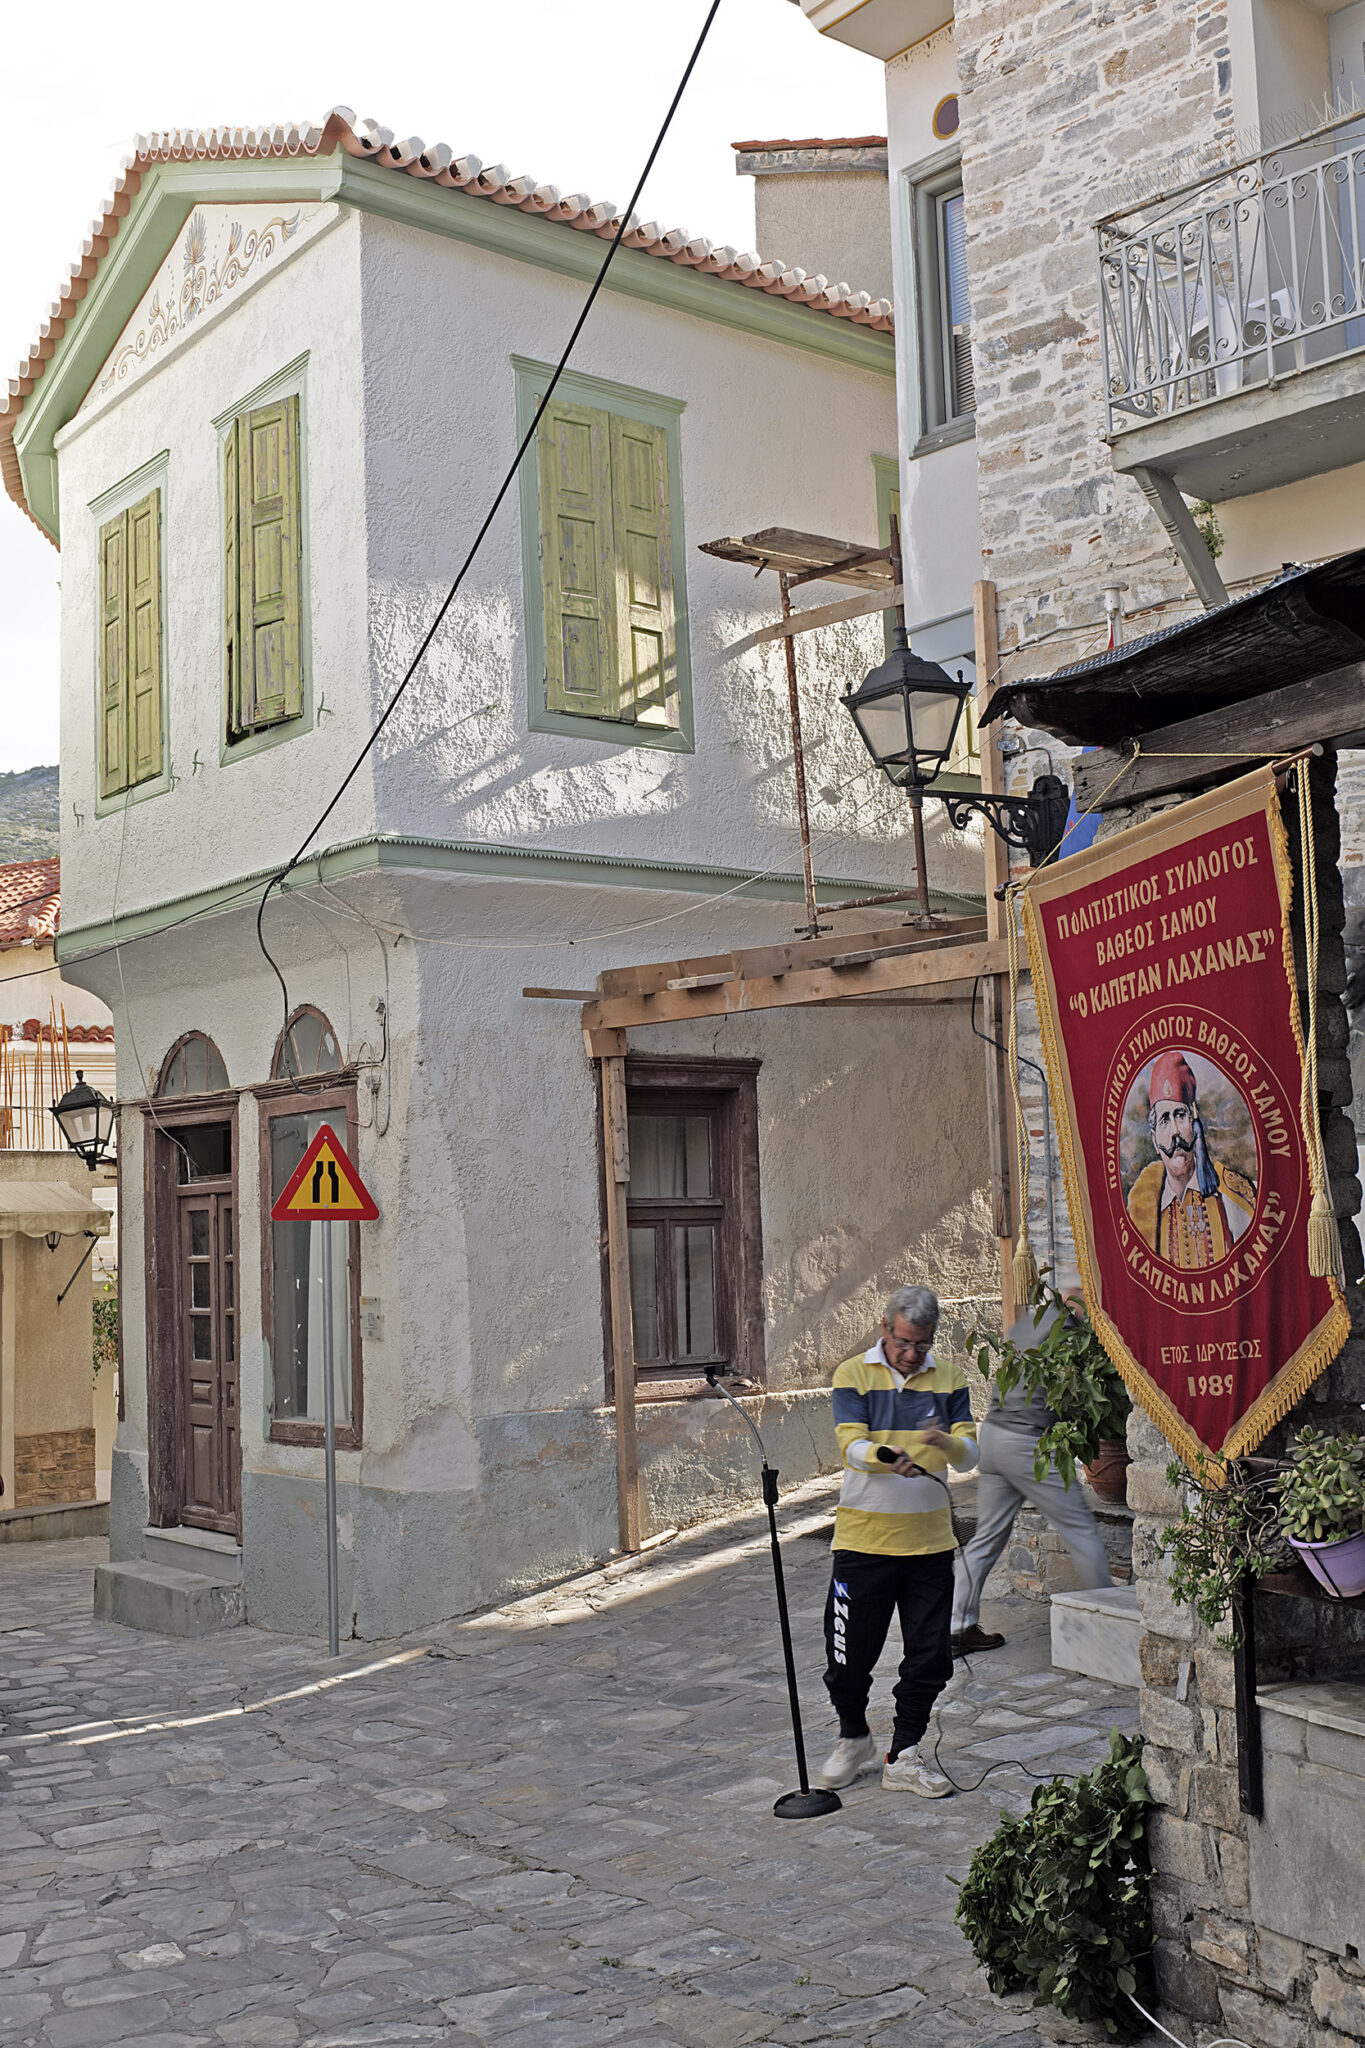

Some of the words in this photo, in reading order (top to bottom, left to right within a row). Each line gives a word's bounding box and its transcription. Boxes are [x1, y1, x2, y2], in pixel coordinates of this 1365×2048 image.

[1056, 875, 1162, 940] ΠΟΛΙΤΙΣΤΙΚΟΣ
[1165, 836, 1259, 896] ΣΥΛΛΟΓΟΣ
[1096, 920, 1155, 967] ΒΑΘΕΟΣ
[1160, 895, 1218, 942] ΣΑΜΟΥ
[1090, 963, 1163, 1015] ΚΑΠΕΤΑΝ
[1105, 1052, 1132, 1190] ΠΟΛΙΤΙΣΤΙΚΟΣ
[1128, 1015, 1194, 1062] ΣΥΛΛΟΓΟΣ
[1197, 1020, 1258, 1084] ΒΑΘΕΟΣ
[1250, 1080, 1292, 1158] ΣΑΜΟΥ
[1127, 1245, 1205, 1305] ΚΑΠΕΤΑΝ
[1160, 1345, 1193, 1365] ΕΤΟΣ
[1196, 1339, 1262, 1362] ΙΔΡΥΣΕΩΣ
[1187, 1374, 1234, 1397] 1989
[833, 1596, 849, 1666] Zeus
